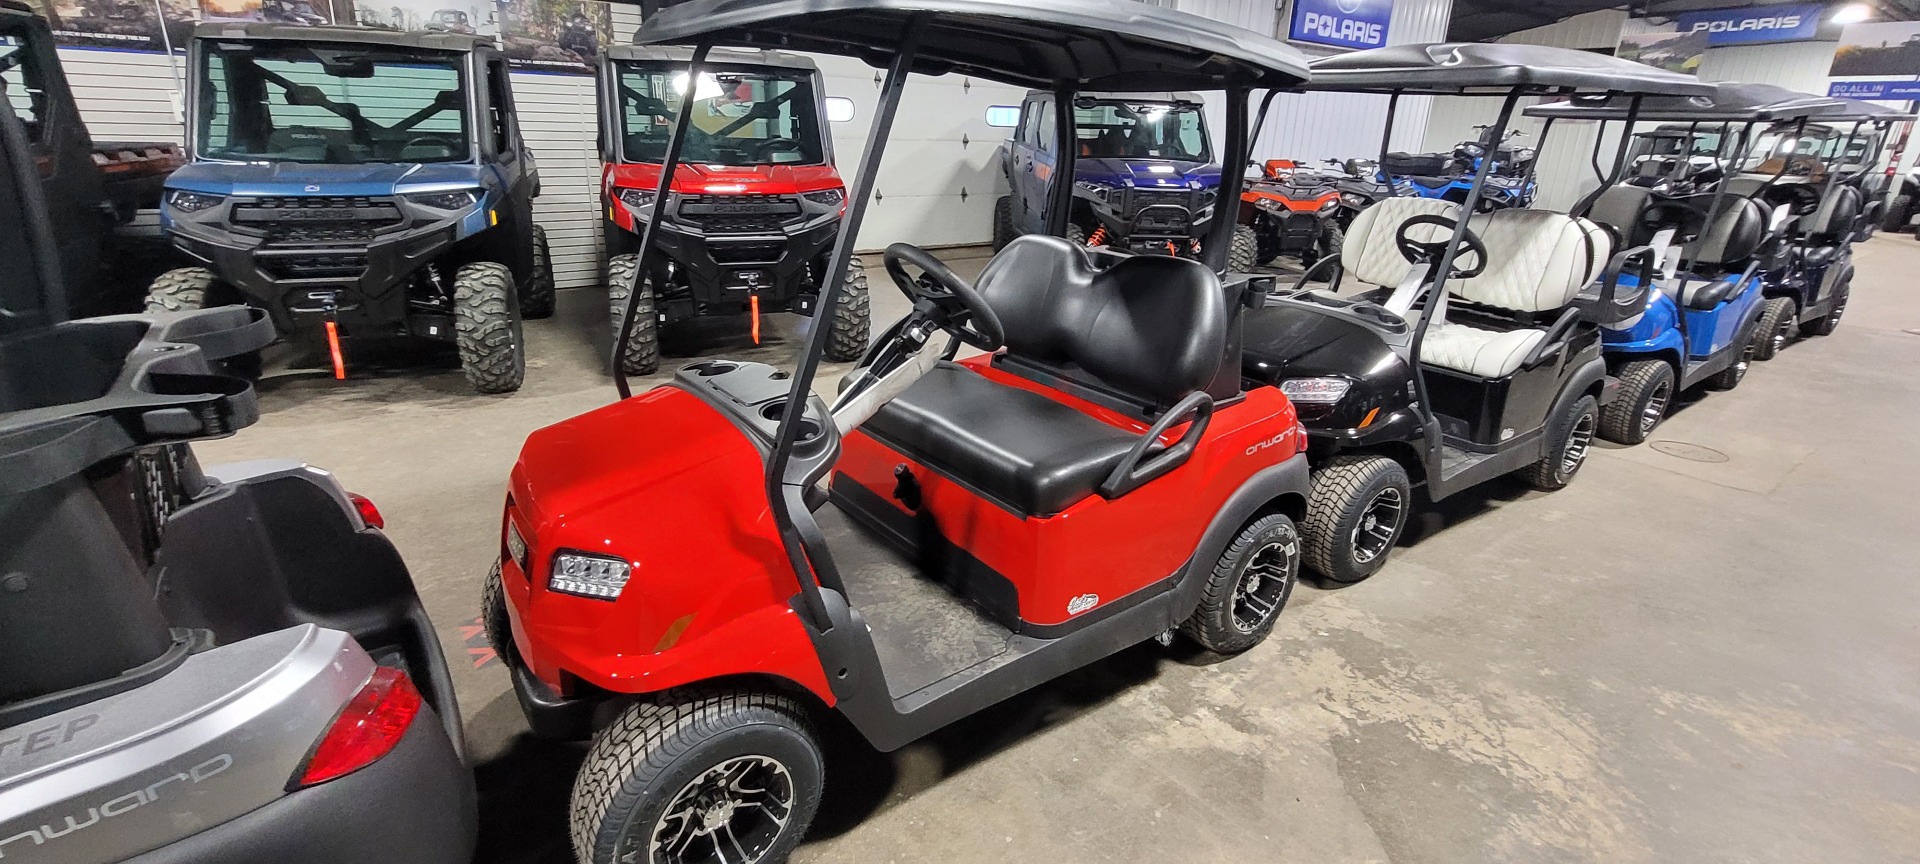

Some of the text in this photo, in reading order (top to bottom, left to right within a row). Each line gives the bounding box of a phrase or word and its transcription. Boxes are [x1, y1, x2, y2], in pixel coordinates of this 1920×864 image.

[1303, 12, 1382, 45] POLARIS
[1689, 15, 1801, 36] POLARIS
[278, 210, 355, 220] POLARIS
[714, 205, 769, 213] POLARIS
[0, 753, 233, 859] nward
